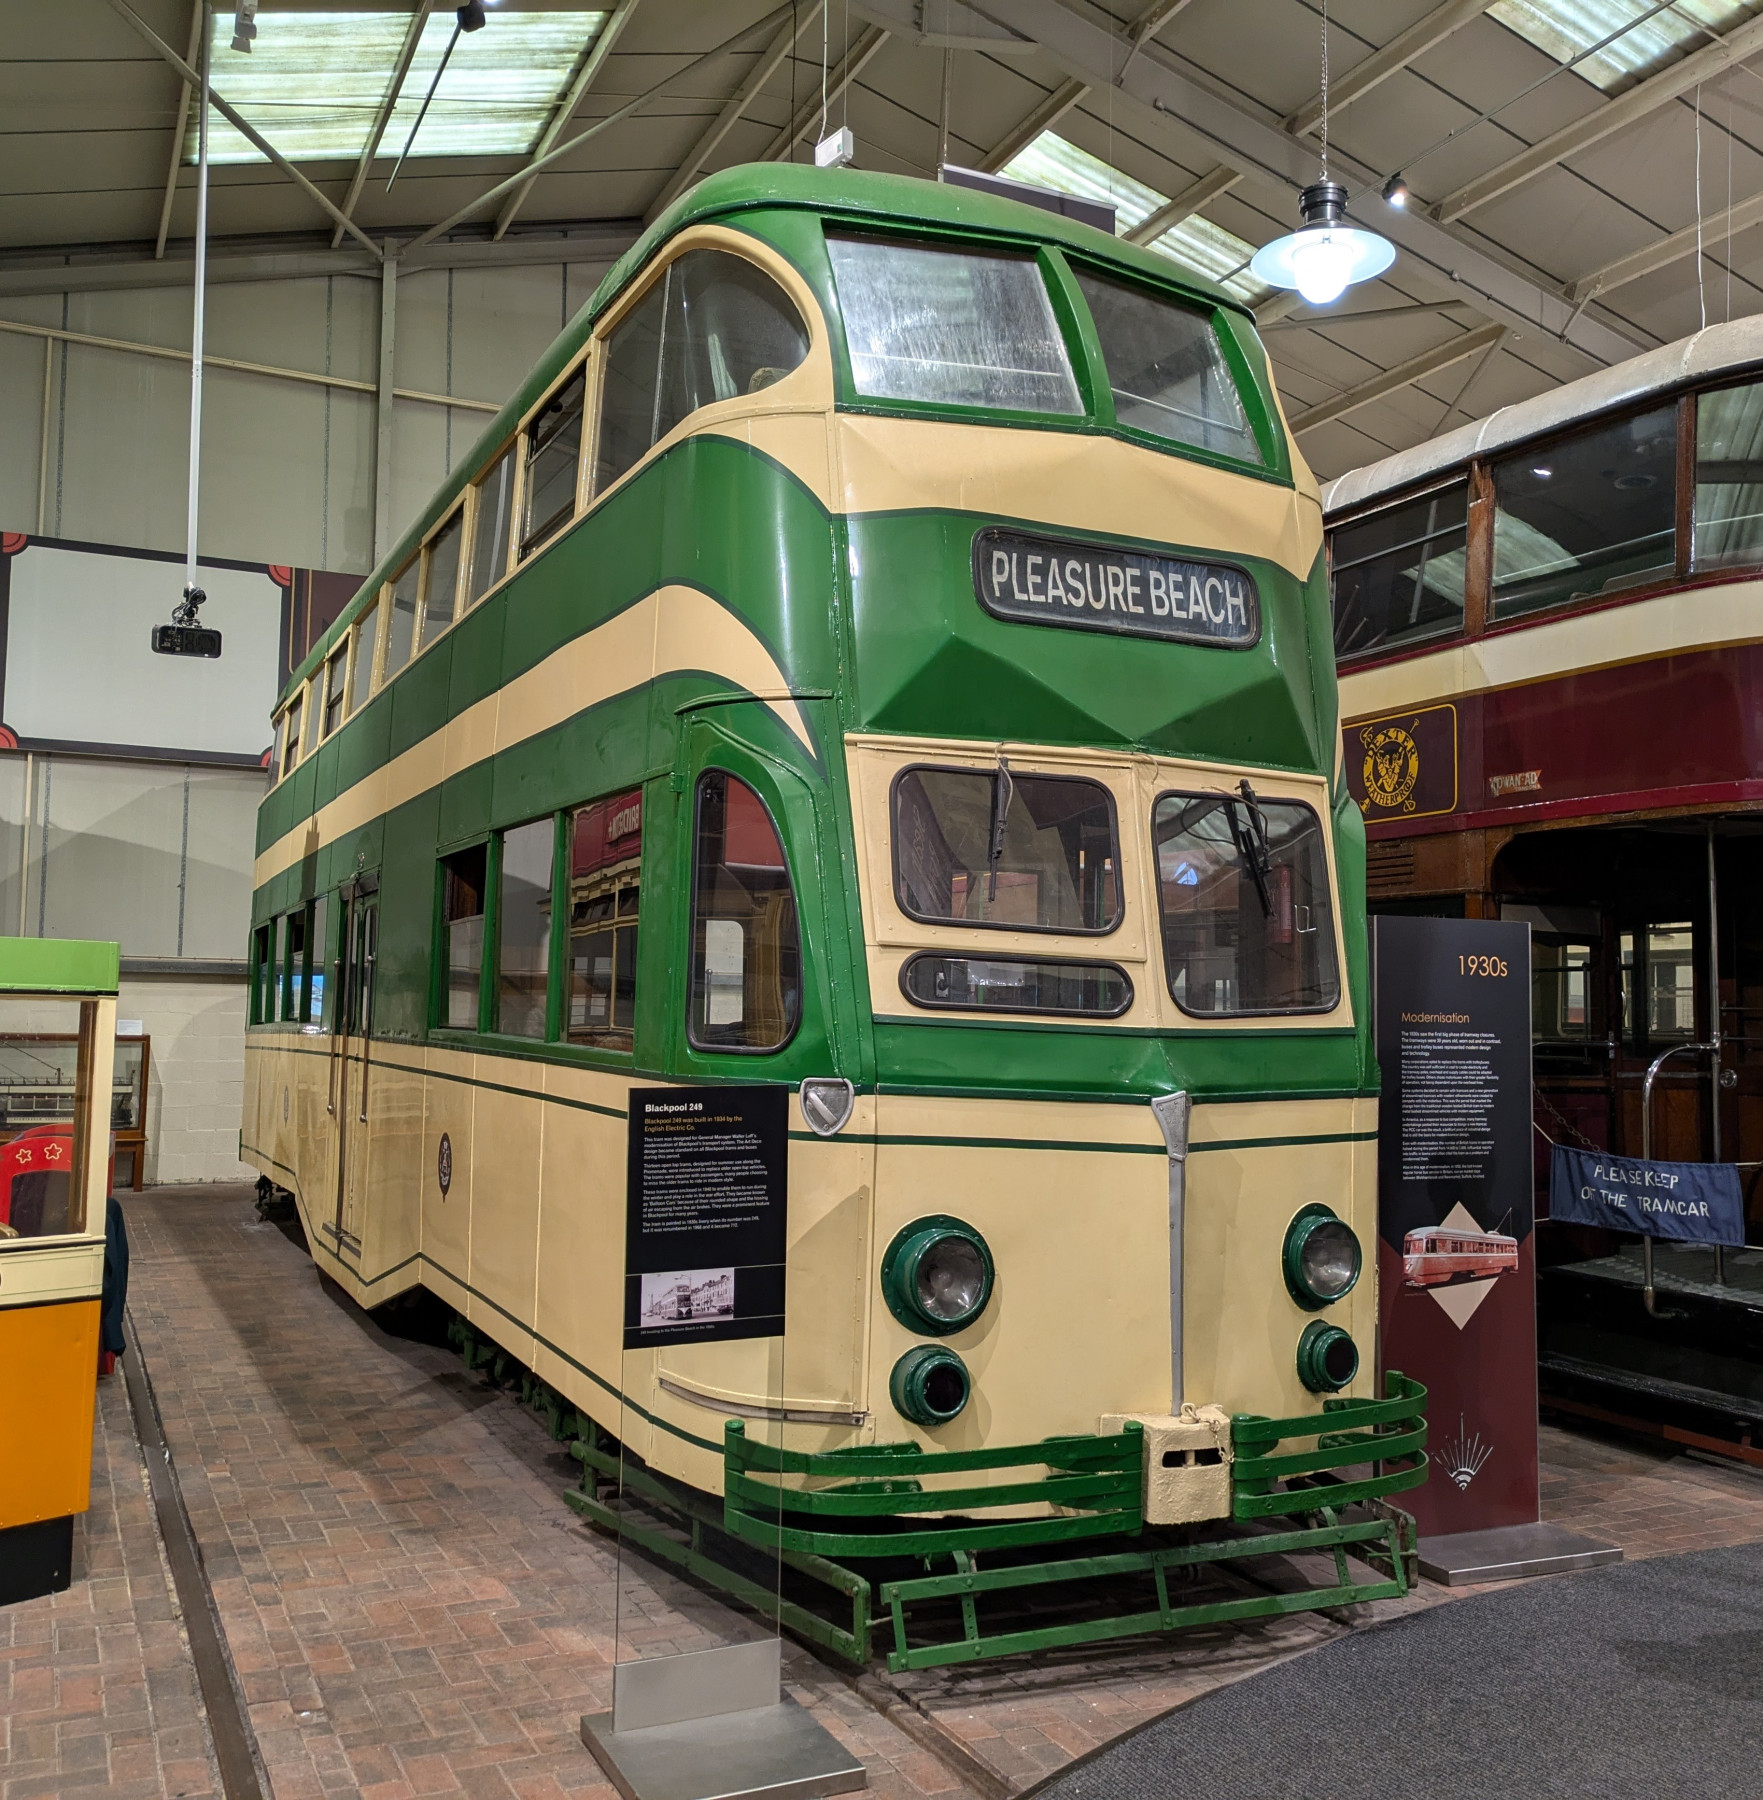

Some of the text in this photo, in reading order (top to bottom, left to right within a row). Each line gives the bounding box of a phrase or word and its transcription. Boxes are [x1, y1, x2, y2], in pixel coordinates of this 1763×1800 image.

[992, 550, 1247, 626] PLEASURE BEACH
[1365, 771, 1416, 806] WEATHERPROOF
[1458, 955, 1508, 977] 1930s
[1401, 1011, 1470, 1024] Modernisation
[645, 1103, 703, 1113] Blackpool 249
[645, 1117, 672, 1125] Blackpool
[726, 1115, 733, 1123] by
[1593, 1164, 1679, 1189] PLEASE KEEP
[1600, 1189, 1628, 1208] THE
[1637, 1195, 1710, 1219] TRAMCAR
